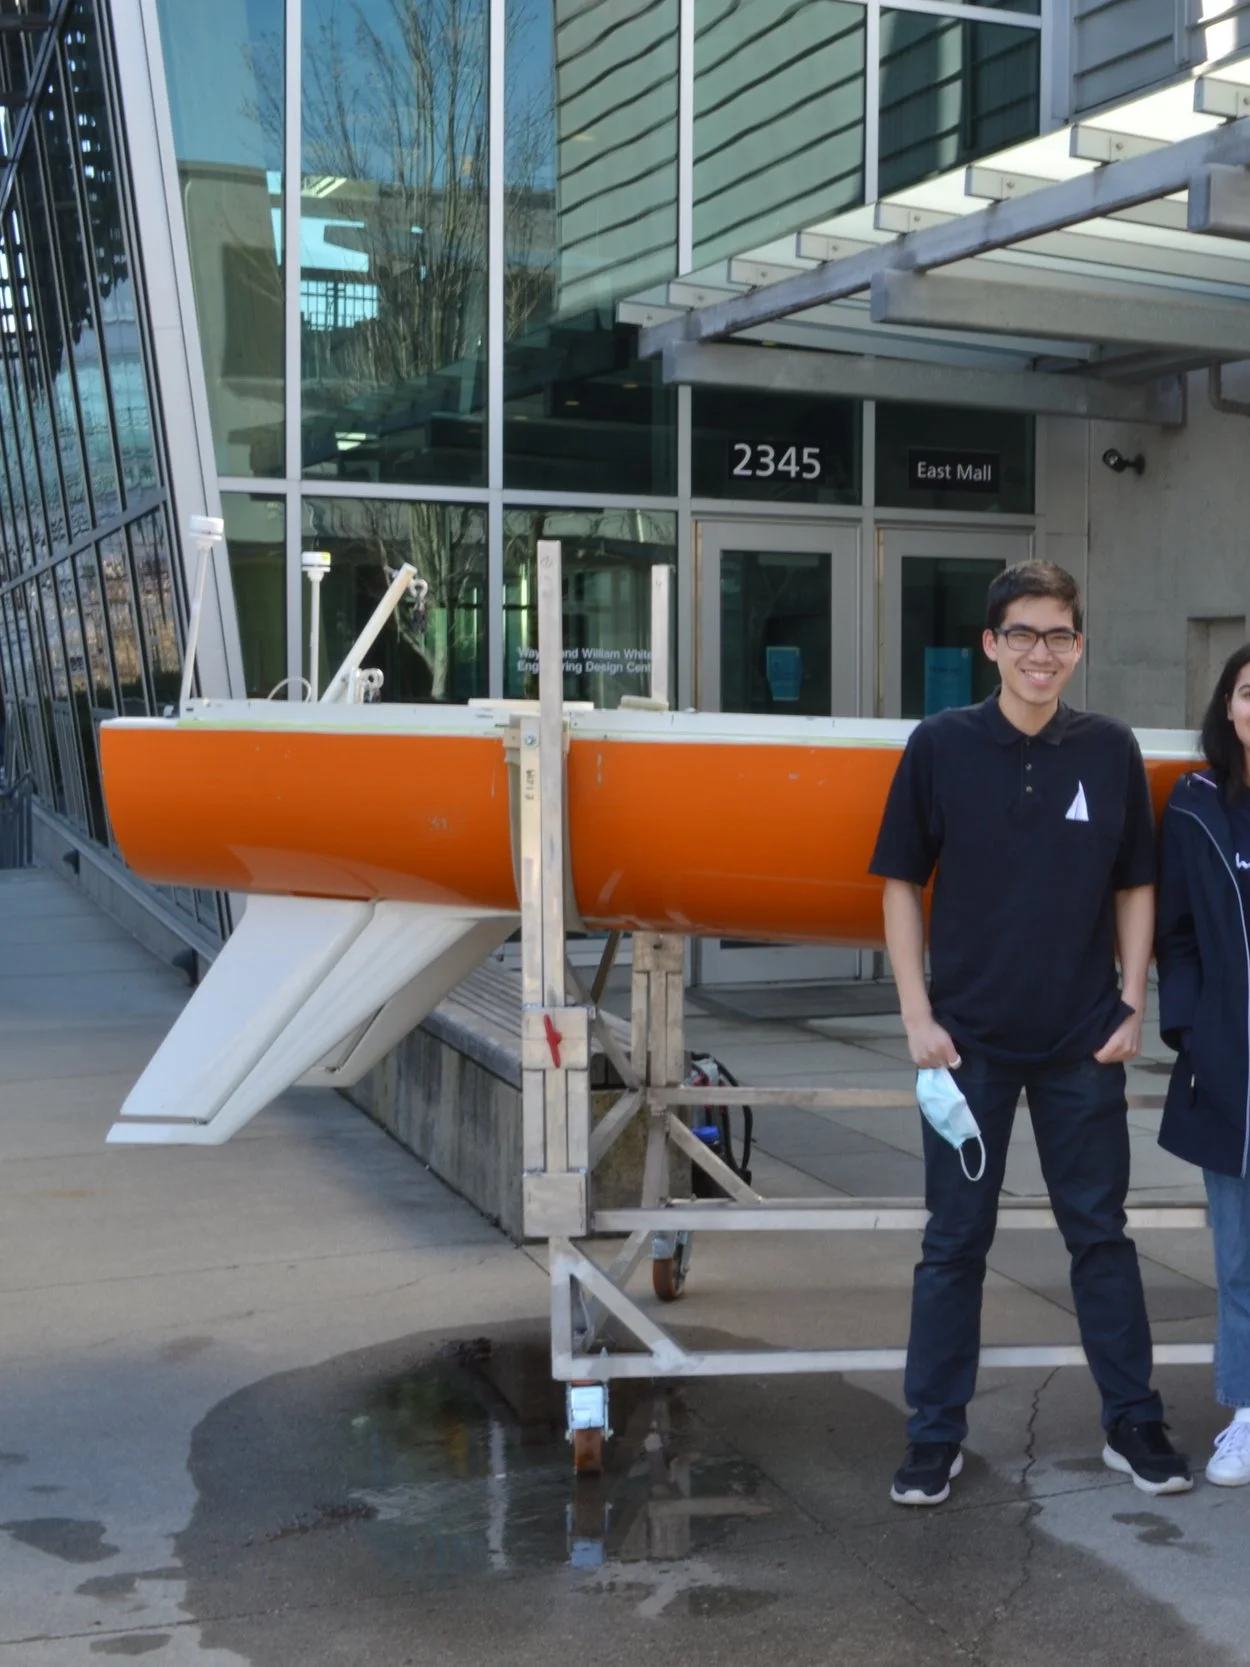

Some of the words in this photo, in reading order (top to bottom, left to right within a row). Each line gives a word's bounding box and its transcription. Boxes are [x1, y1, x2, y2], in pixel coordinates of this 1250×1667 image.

[732, 443, 821, 479] 2345
[917, 461, 951, 480] East
[956, 463, 992, 482] Mall
[582, 647, 620, 660] William
[585, 660, 624, 675] Design
[626, 661, 652, 673] Cent
